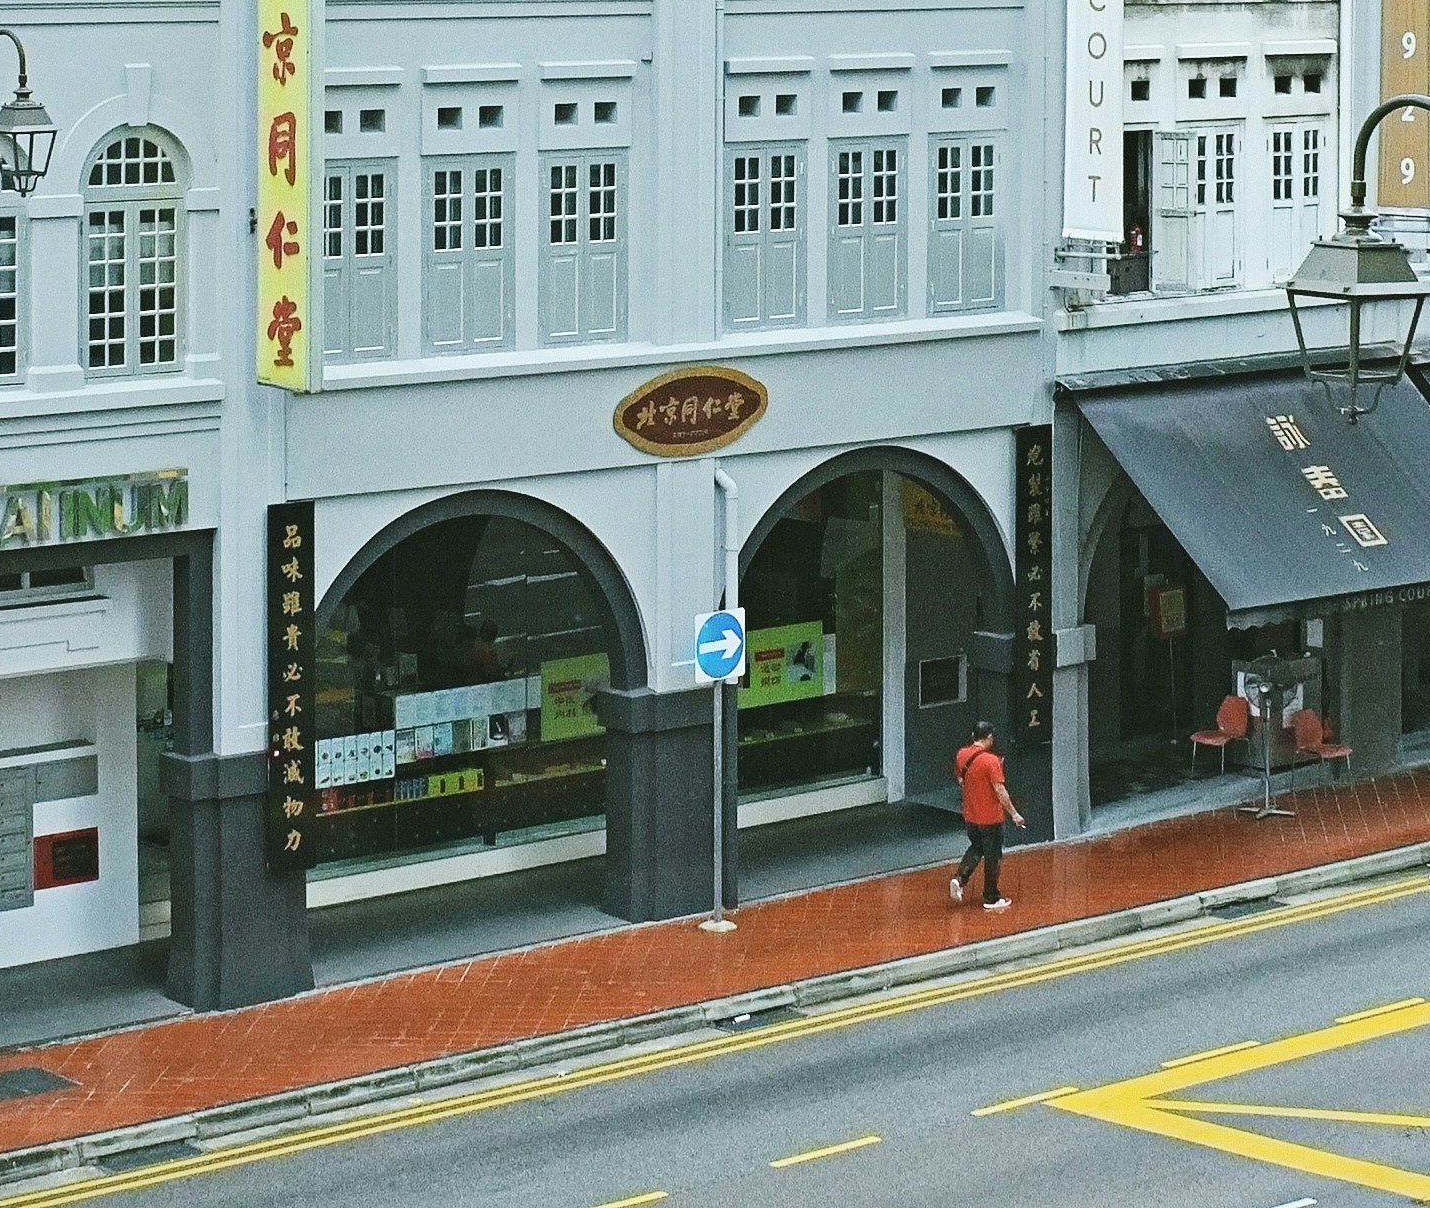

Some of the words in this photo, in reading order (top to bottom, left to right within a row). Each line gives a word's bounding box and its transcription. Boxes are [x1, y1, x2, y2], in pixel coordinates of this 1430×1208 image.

[636, 391, 745, 430] 北京同仁堂
